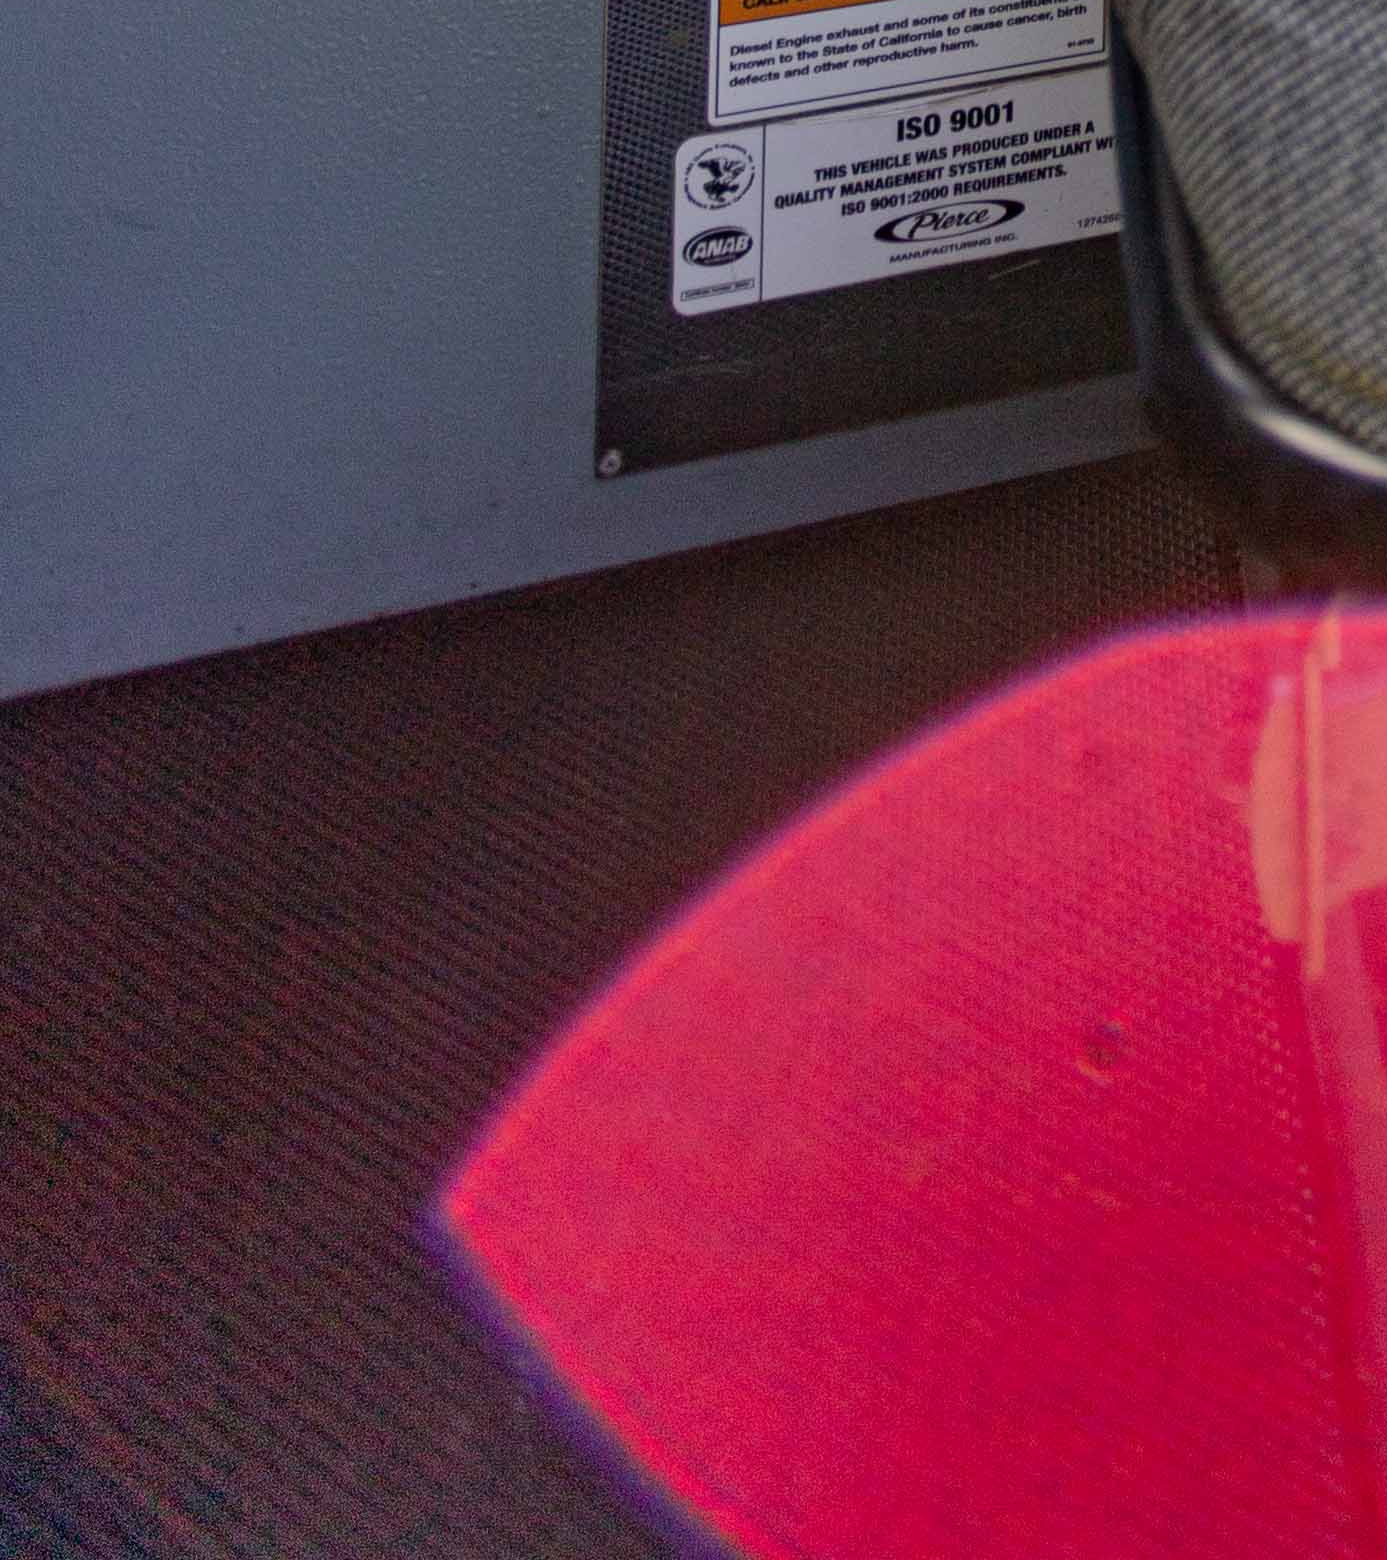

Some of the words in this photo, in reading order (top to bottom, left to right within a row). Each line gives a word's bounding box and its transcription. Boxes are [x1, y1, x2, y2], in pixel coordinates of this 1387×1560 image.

[729, 57, 775, 72] known
[779, 52, 793, 63] to
[797, 47, 818, 61] the
[823, 40, 858, 57] State
[861, 36, 876, 50] of
[879, 27, 943, 48] California
[947, 25, 960, 36] to
[964, 19, 1003, 34] cause
[1007, 10, 1054, 27] cancer,
[1057, 2, 1087, 19] birth
[730, 40, 773, 57] Diesel
[776, 32, 823, 51] Engine
[826, 23, 880, 41] exhaust
[883, 17, 909, 32] and
[912, 14, 948, 27] some
[952, 7, 967, 20] of
[969, 6, 985, 18] its
[729, 68, 780, 88] defects
[784, 63, 810, 78] and
[813, 56, 848, 73] other
[852, 46, 937, 69] reproductive
[940, 38, 979, 53] harm.
[897, 113, 941, 143] ISO
[950, 100, 1014, 133] 9001
[774, 186, 836, 210] QUALITY
[840, 166, 945, 198] MANAGEMENT
[948, 156, 1006, 178] SYSTEM
[1011, 140, 1093, 166] COMPLIANT
[1096, 136, 1117, 151] WI
[814, 164, 848, 182] THIS
[851, 153, 911, 176] VEHICLE
[915, 146, 948, 164] WAS
[952, 132, 1029, 158] PRODUCED
[1034, 123, 1081, 143] UNDER
[1085, 120, 1095, 134] A
[841, 201, 866, 217] ISO
[870, 185, 949, 211] 9001:2000
[953, 164, 1067, 196] REQUIREMENTS.
[693, 234, 750, 259] ANAB
[889, 235, 992, 265] MANUFACTURING
[995, 231, 1018, 245] INC.
[908, 208, 990, 240] Pierce
